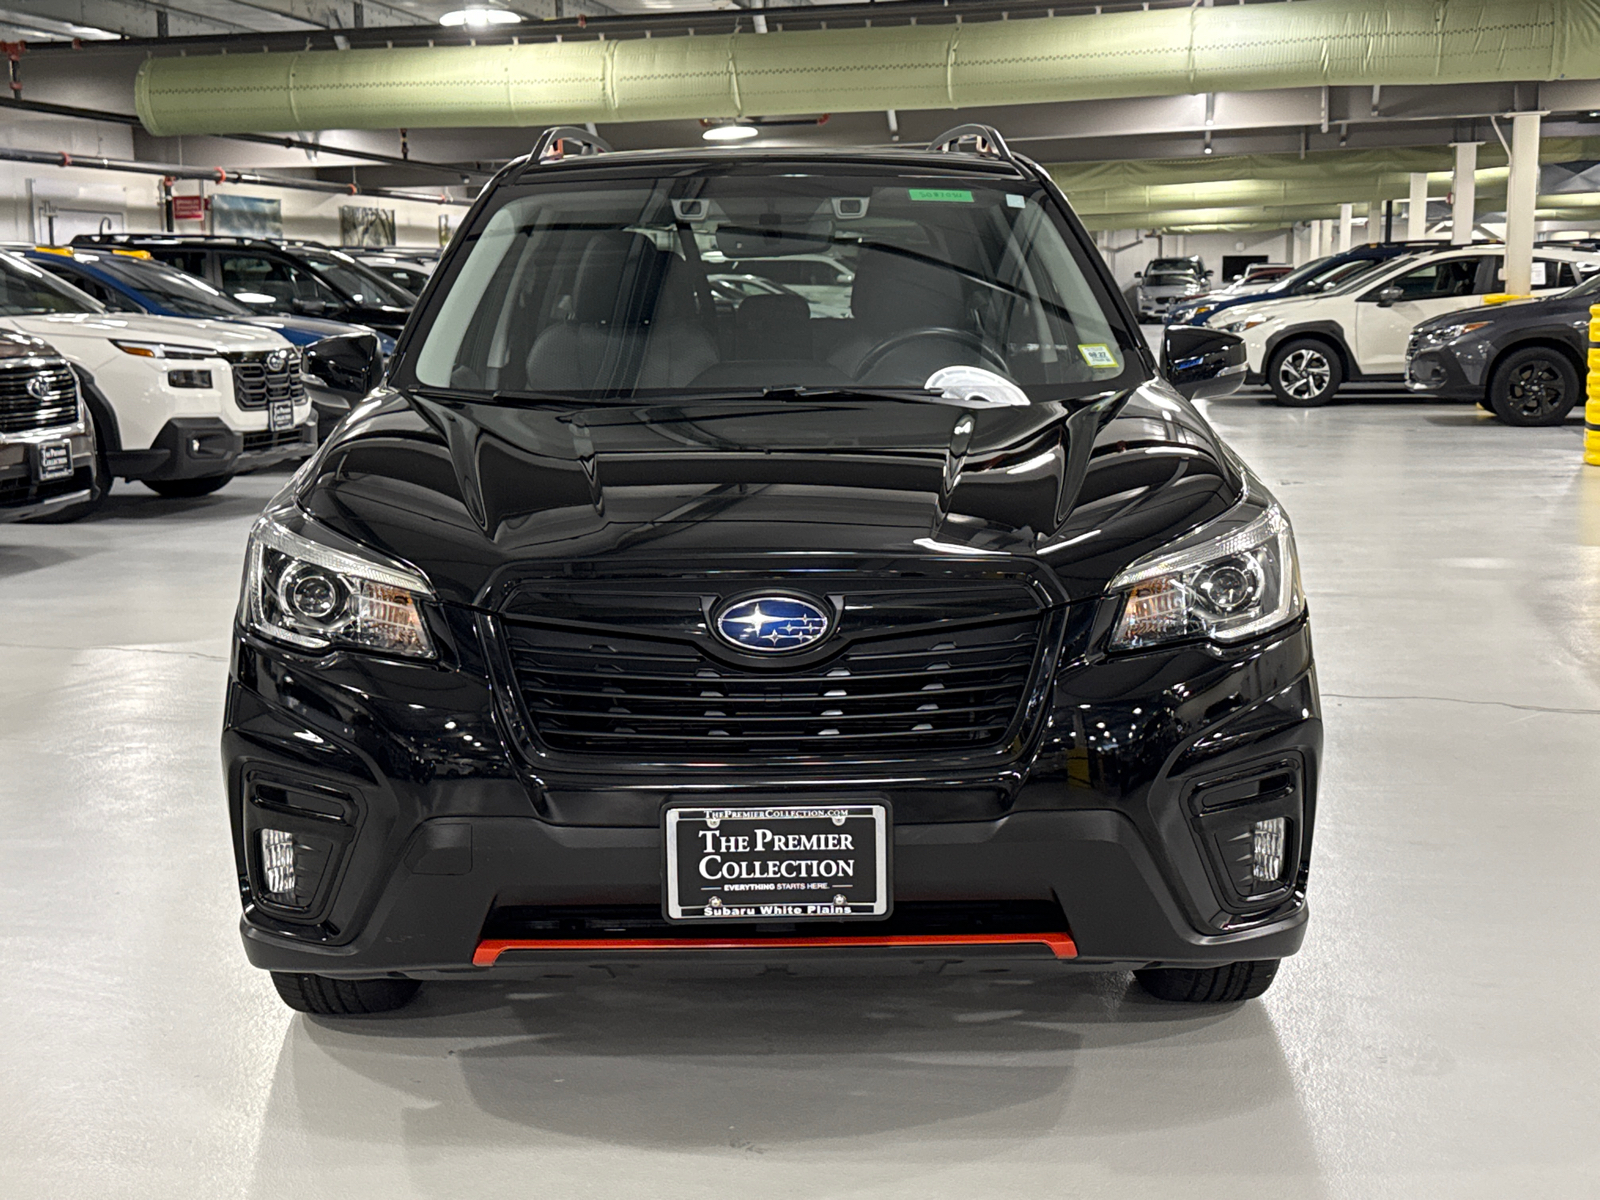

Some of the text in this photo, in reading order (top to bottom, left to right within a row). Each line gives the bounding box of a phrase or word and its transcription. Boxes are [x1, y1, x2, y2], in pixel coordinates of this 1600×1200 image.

[698, 829, 855, 853] THE PREMIER
[699, 855, 854, 880] COLLECTION
[807, 882, 830, 890] HERE.
[704, 905, 852, 916] Subaru White Plains
